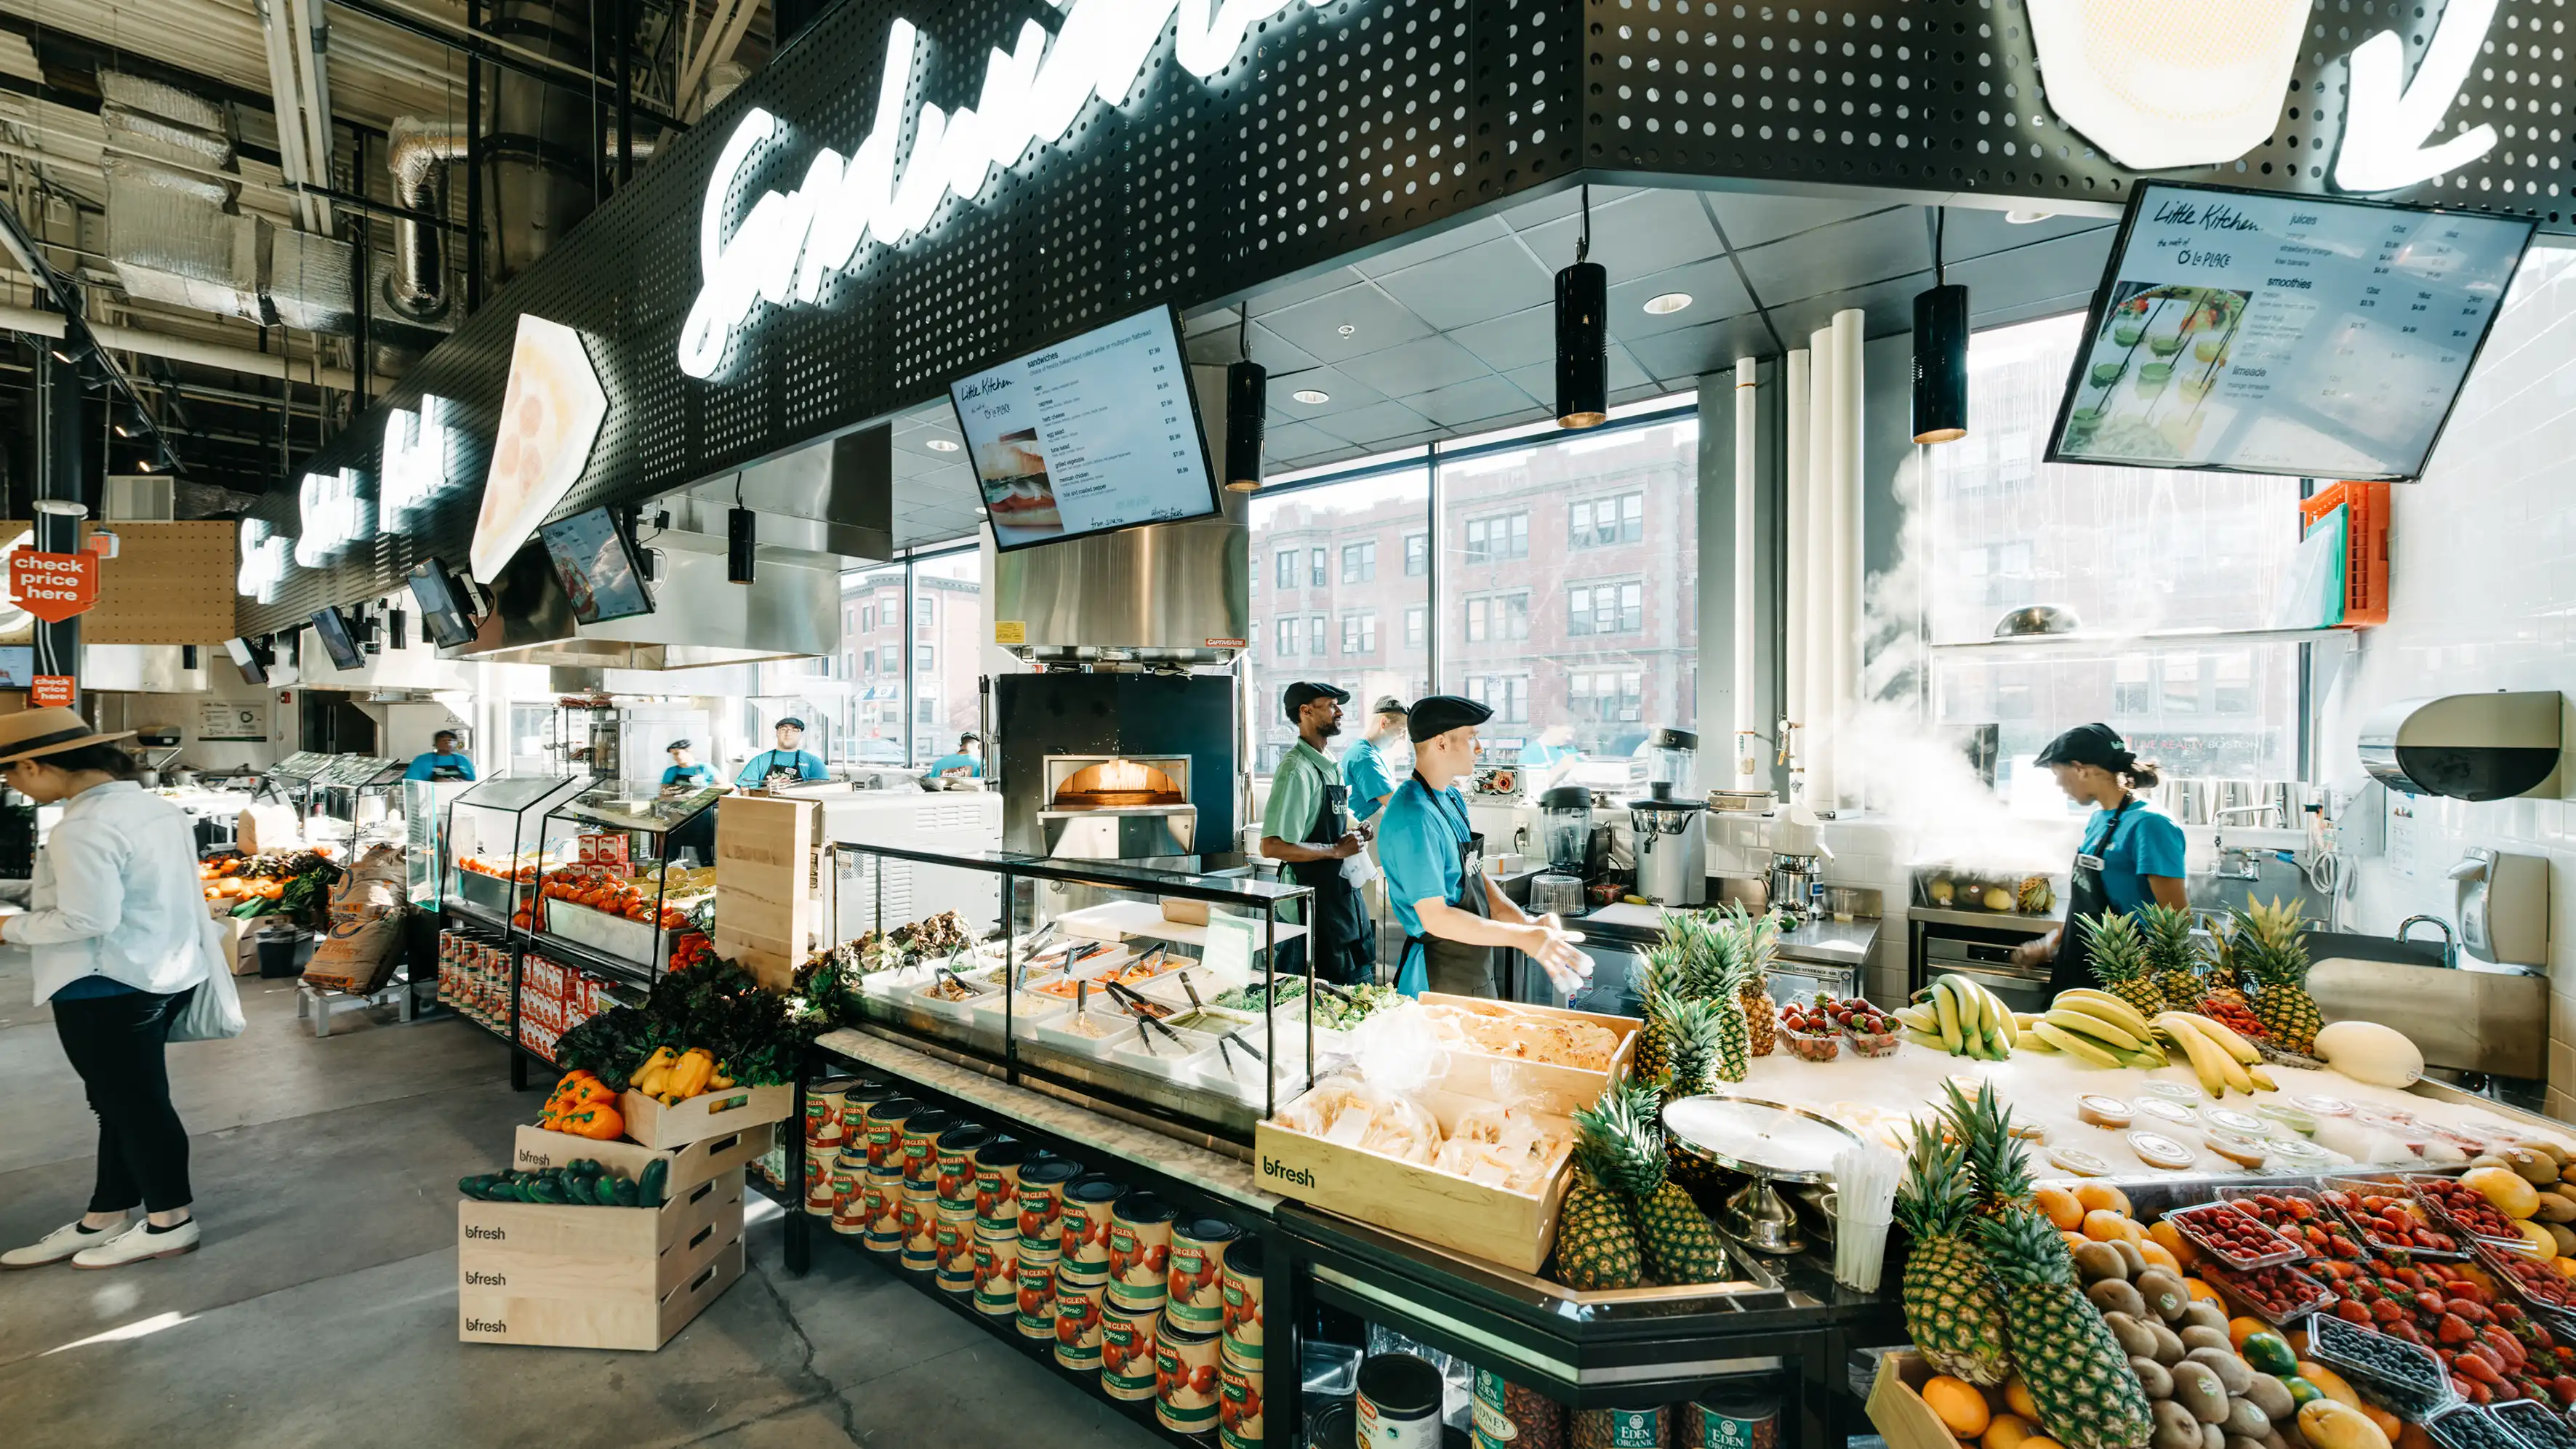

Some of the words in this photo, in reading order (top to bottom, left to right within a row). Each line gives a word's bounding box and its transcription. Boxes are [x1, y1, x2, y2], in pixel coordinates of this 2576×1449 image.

[2154, 201, 2195, 224] Little
[2289, 212, 2317, 225] juices
[2202, 252, 2231, 268] PLACE
[2266, 278, 2312, 289] smoothies
[1030, 367, 1042, 377] choice
[1059, 358, 1072, 367] baked
[1071, 354, 1083, 363] hand
[1083, 349, 1094, 359] rolled
[1094, 345, 1105, 354] white
[1112, 337, 1131, 348] multigrain
[1132, 329, 1152, 341] flatbread
[1148, 347, 1160, 356] $7.99
[1027, 352, 1059, 369] sandwiches
[2232, 365, 2266, 377] limeade
[961, 382, 981, 401] Little
[1055, 460, 1067, 470] grilled
[1067, 457, 1085, 465] vegetable
[1059, 475, 1075, 483] mexican
[15, 555, 84, 574] check
[21, 571, 79, 587] price
[27, 585, 78, 601] here
[35, 677, 70, 686] check
[2135, 739, 2156, 750] LIVE
[2208, 739, 2258, 750] BOSTON
[519, 1149, 550, 1166] bfresh
[1263, 1155, 1315, 1189] bfresh
[465, 1225, 505, 1240] bfresh
[466, 1272, 506, 1285] bfresh
[466, 1318, 507, 1333] bfresh
[1621, 1426, 1650, 1439] EDEN
[1712, 1429, 1744, 1447] EDEN
[1616, 1438, 1655, 1448] ORGANIC
